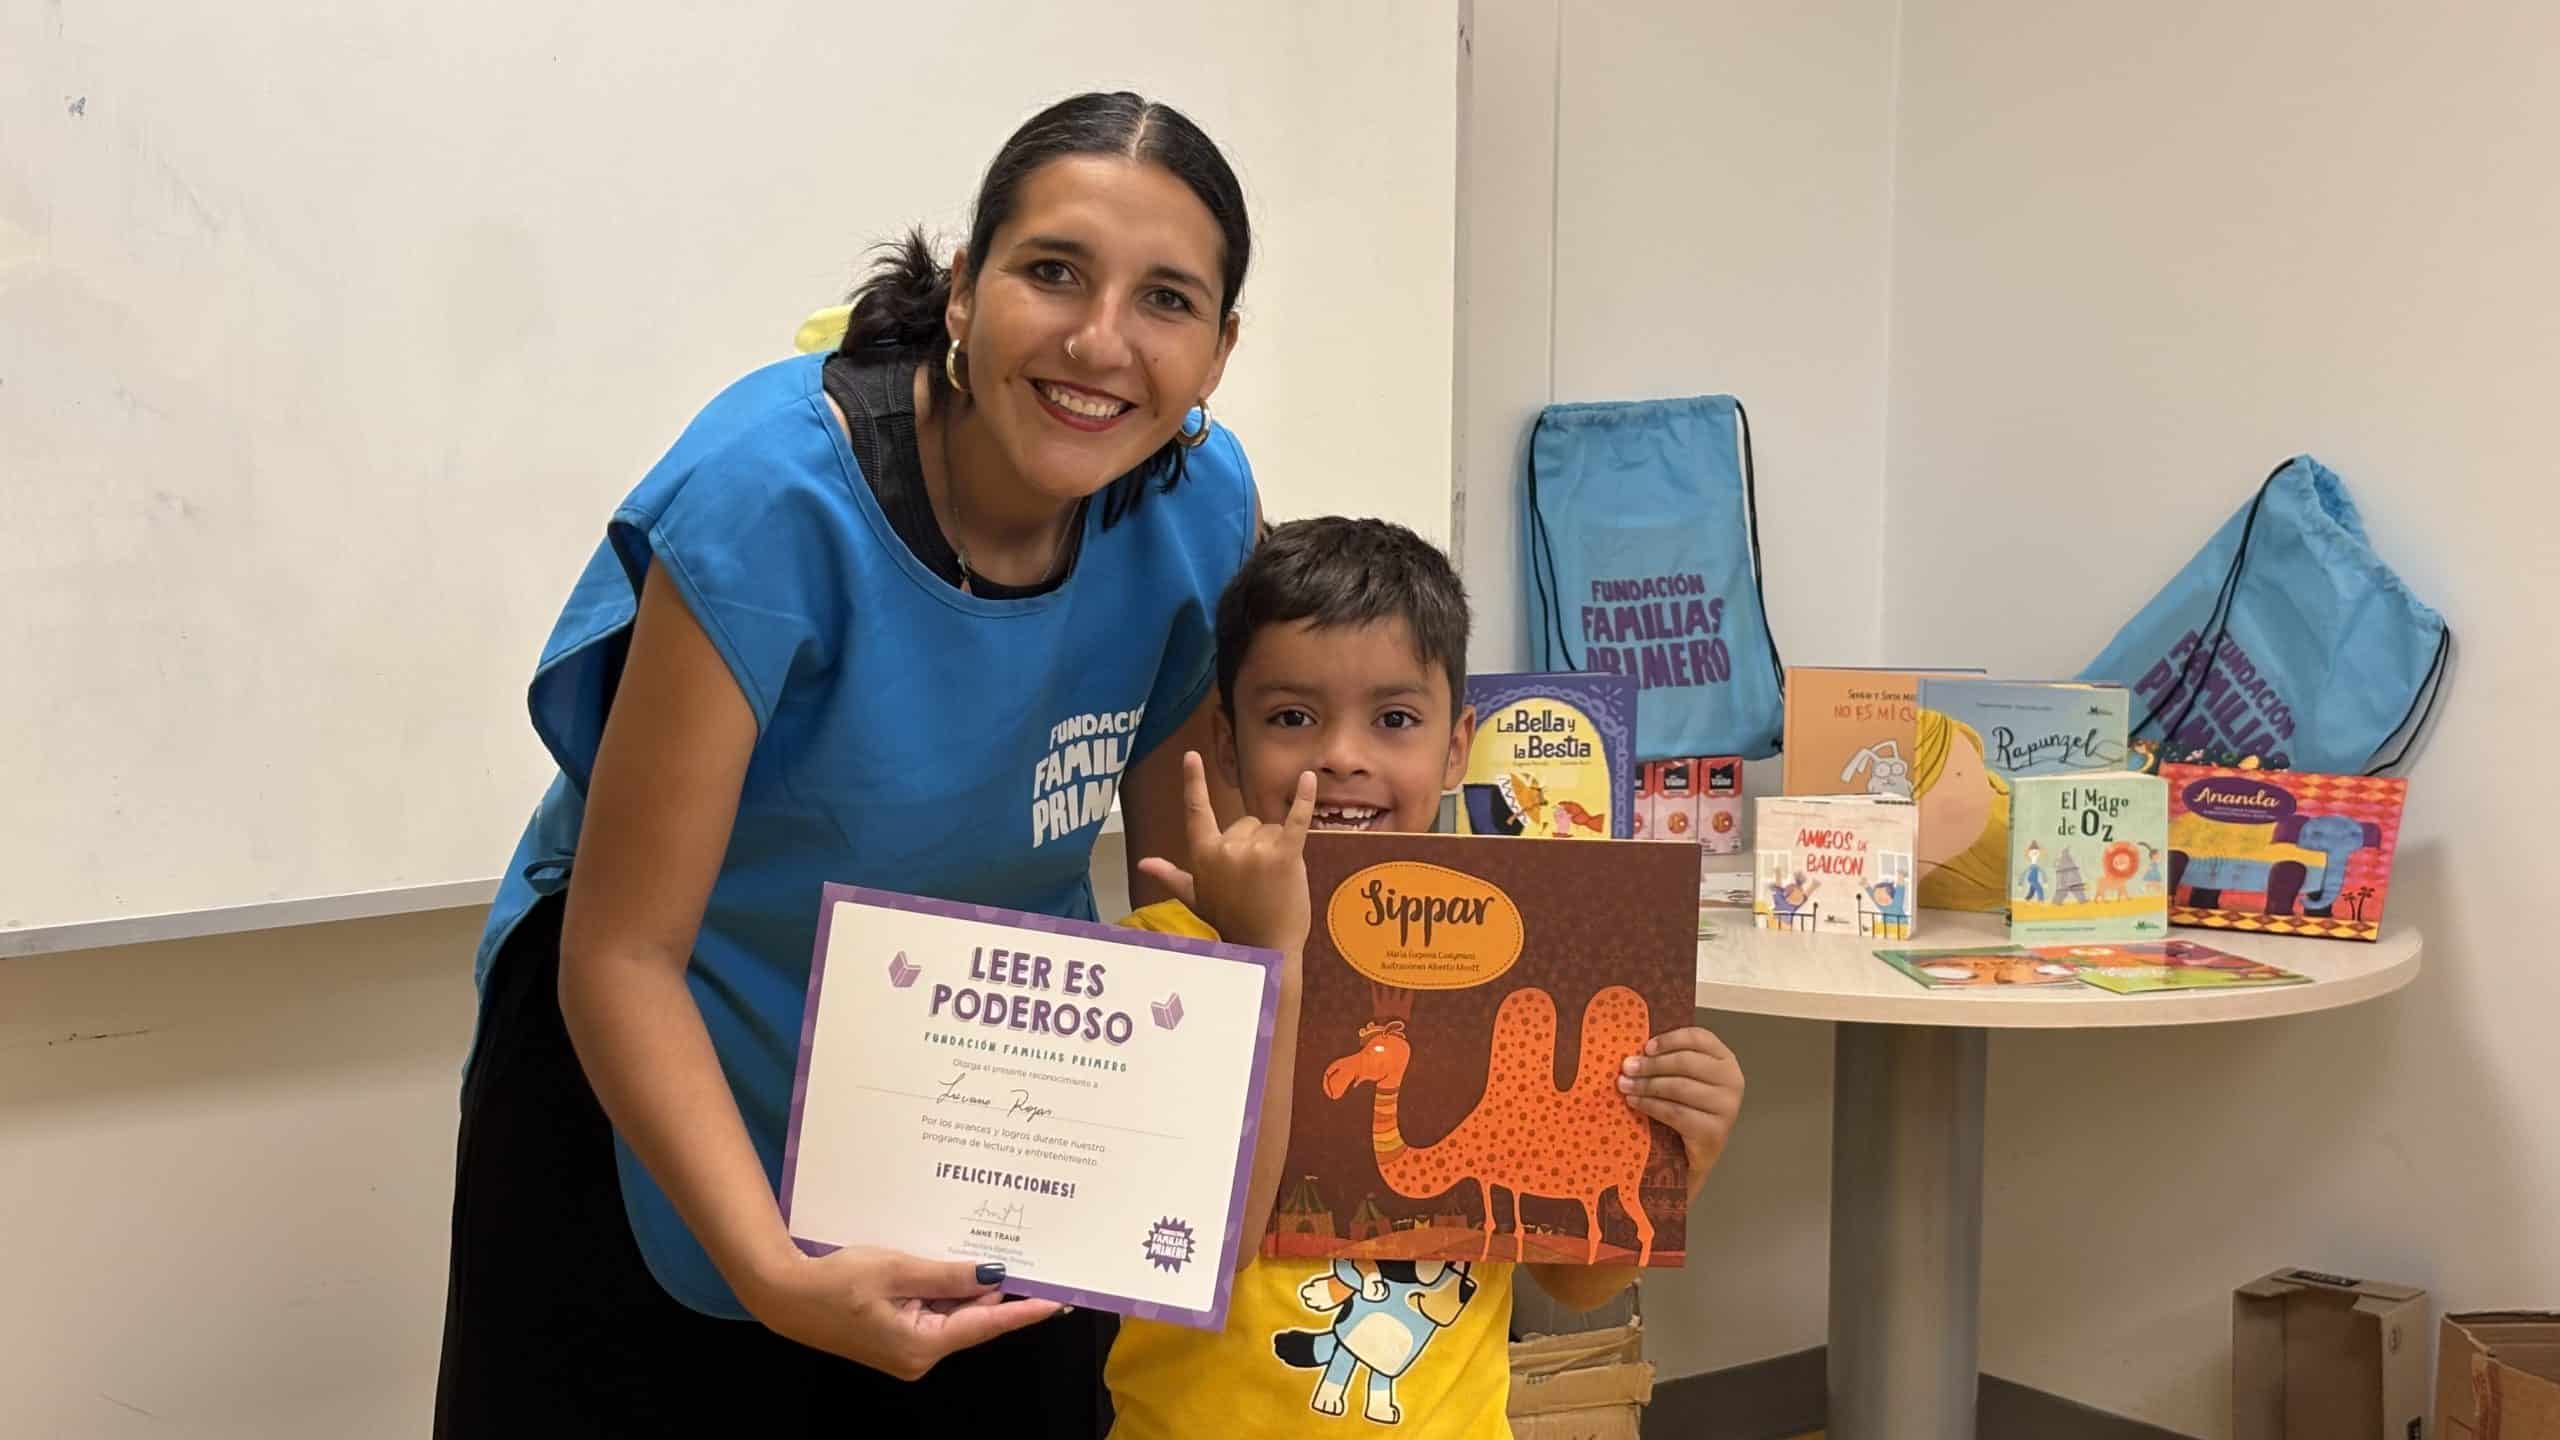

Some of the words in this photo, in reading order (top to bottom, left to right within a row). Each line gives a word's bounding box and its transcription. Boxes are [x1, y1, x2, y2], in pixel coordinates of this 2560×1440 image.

[1592, 573, 1705, 602] FUNDACIÓN
[1581, 597, 1725, 643] FAMILIAS
[1586, 637, 1731, 690] PRIMERO
[1497, 718, 1514, 733] La
[1515, 709, 1565, 733] Bella
[1567, 718, 1576, 733] y
[1833, 704, 1851, 720] NO
[1855, 703, 1873, 721] ES
[2134, 657, 2220, 749] PRIM
[1050, 701, 1147, 750] FUNDACIÓ
[1514, 743, 1526, 759] la
[1528, 735, 1591, 758] Bestia
[1991, 725, 2098, 770] Rapunzel
[1032, 777, 1119, 849] PRIM
[2061, 787, 2077, 811] El
[2084, 788, 2129, 818] Mago
[2192, 786, 2280, 808] Ananda
[1796, 828, 1854, 850] AMIGOS
[2057, 816, 2077, 836] de
[2081, 809, 2113, 842] Oz
[1361, 879, 1495, 947] Sippar
[968, 946, 1052, 991] LEER
[1063, 959, 1106, 999] ES
[929, 983, 1133, 1046] PODEROSO
[1003, 1044, 1065, 1062] FAMILIAS
[1071, 1055, 1127, 1073] PRIMERO
[921, 1114, 937, 1126] Por
[940, 1116, 952, 1129] los
[954, 1120, 992, 1135] avances
[1002, 1126, 1031, 1143] logros
[1033, 1131, 1069, 1147] durante
[1070, 1139, 1106, 1153] nuestro
[922, 1131, 967, 1147] programa
[969, 1137, 981, 1148] de
[983, 1140, 1015, 1155] lectura
[936, 1162, 1076, 1199] ¡FELICITACIONES!
